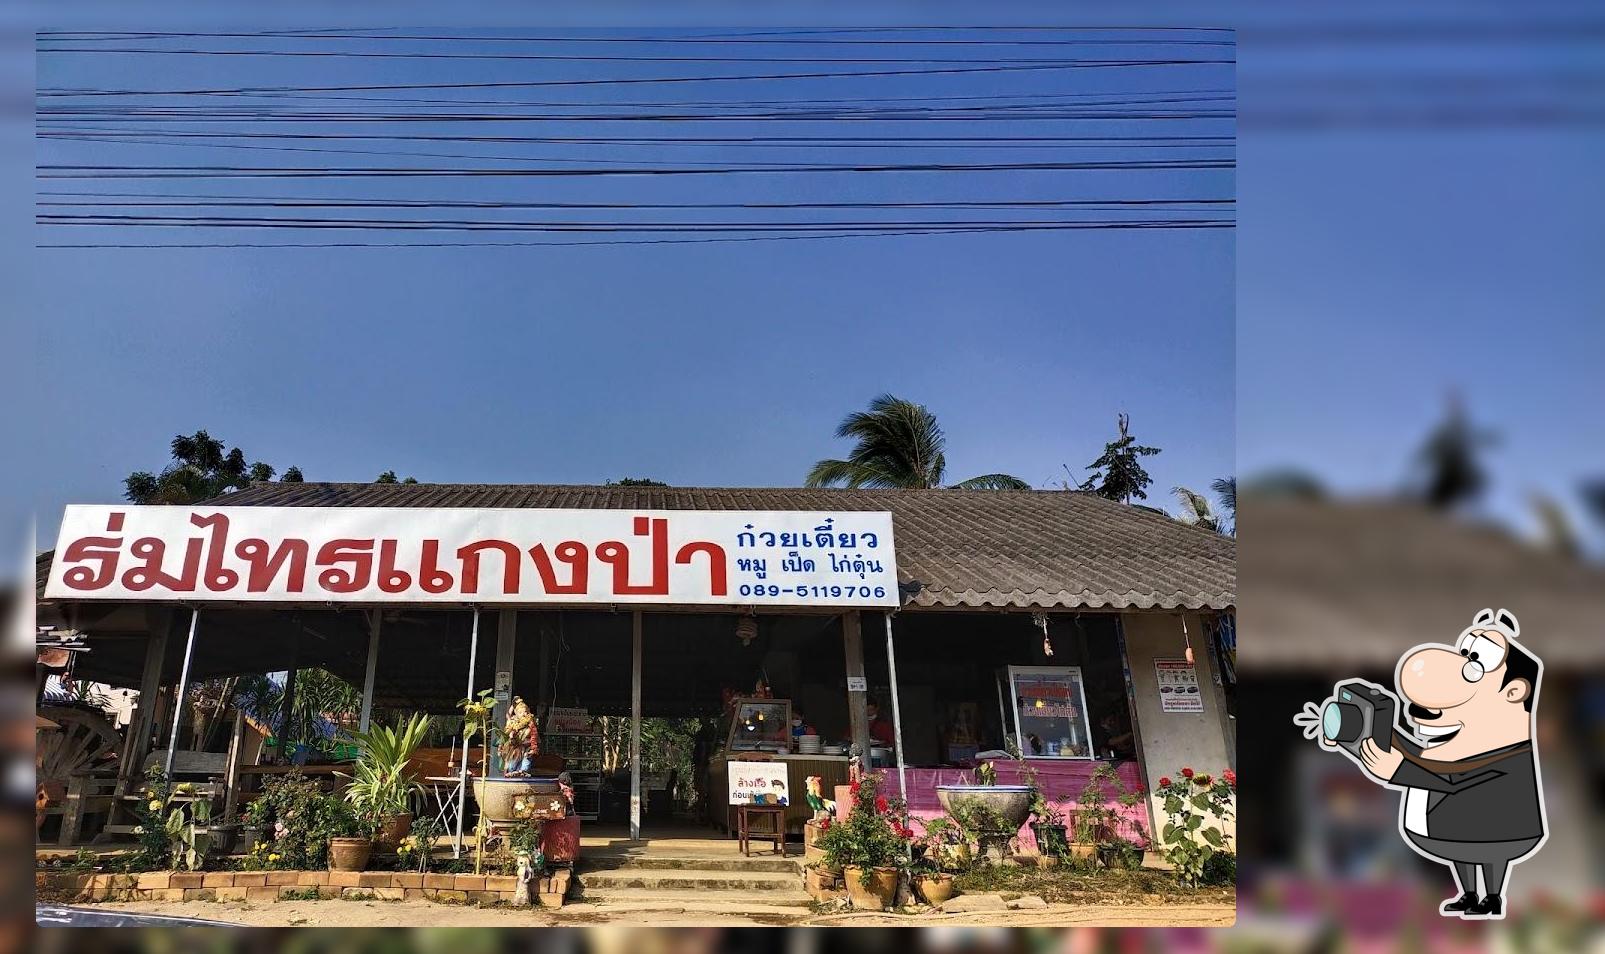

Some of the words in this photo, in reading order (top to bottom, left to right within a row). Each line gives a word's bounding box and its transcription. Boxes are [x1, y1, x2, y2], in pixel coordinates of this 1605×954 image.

[736, 517, 878, 549] ก๋วยเตี๋ยว
[62, 512, 728, 597] ร่มไทรแกงป่า
[737, 557, 767, 580] หมู
[781, 551, 815, 573] เป็ด
[827, 552, 884, 580] ไก่ตุ๋น
[739, 584, 886, 598] 089-5119706
